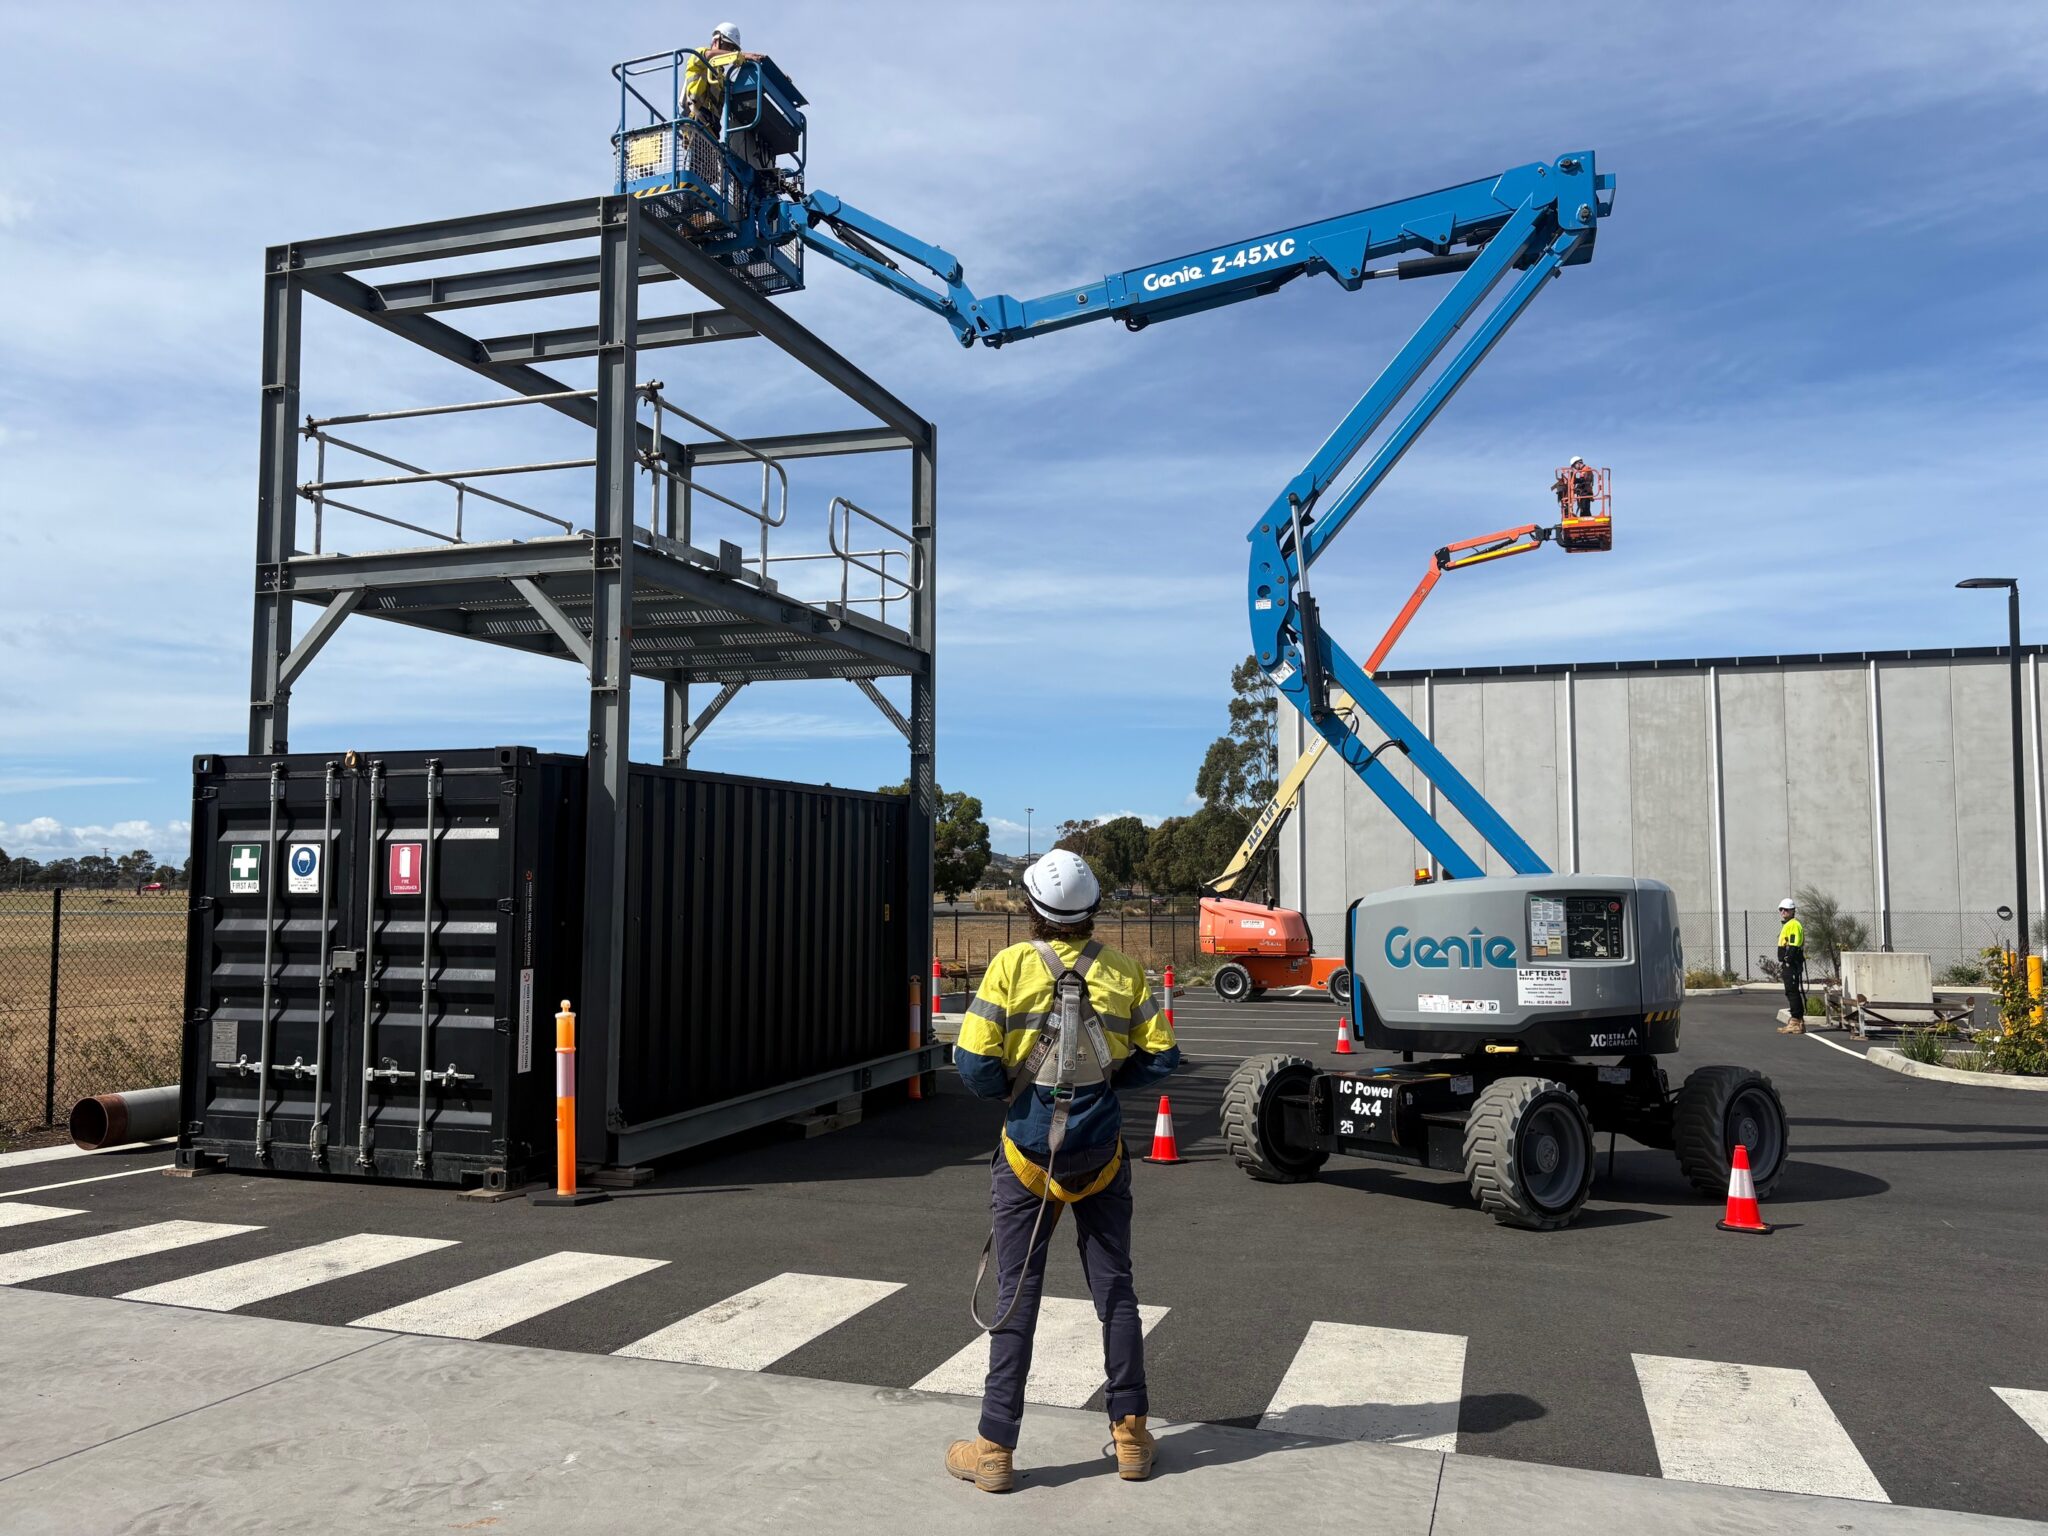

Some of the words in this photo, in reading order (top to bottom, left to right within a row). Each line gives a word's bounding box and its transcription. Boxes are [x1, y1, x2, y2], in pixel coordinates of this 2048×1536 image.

[1143, 265, 1203, 292] Genie
[1211, 238, 1295, 275] Z-45XC
[1247, 827, 1263, 849] JLG
[1260, 798, 1280, 826] LIFT
[232, 882, 246, 890] FIRST
[247, 882, 257, 890] AID
[1385, 926, 1517, 969] Genie
[1590, 1034, 1606, 1047] XC
[1339, 1079, 1353, 1094] IC
[1350, 1097, 1382, 1117] 4x4
[1340, 1120, 1354, 1134] 25
